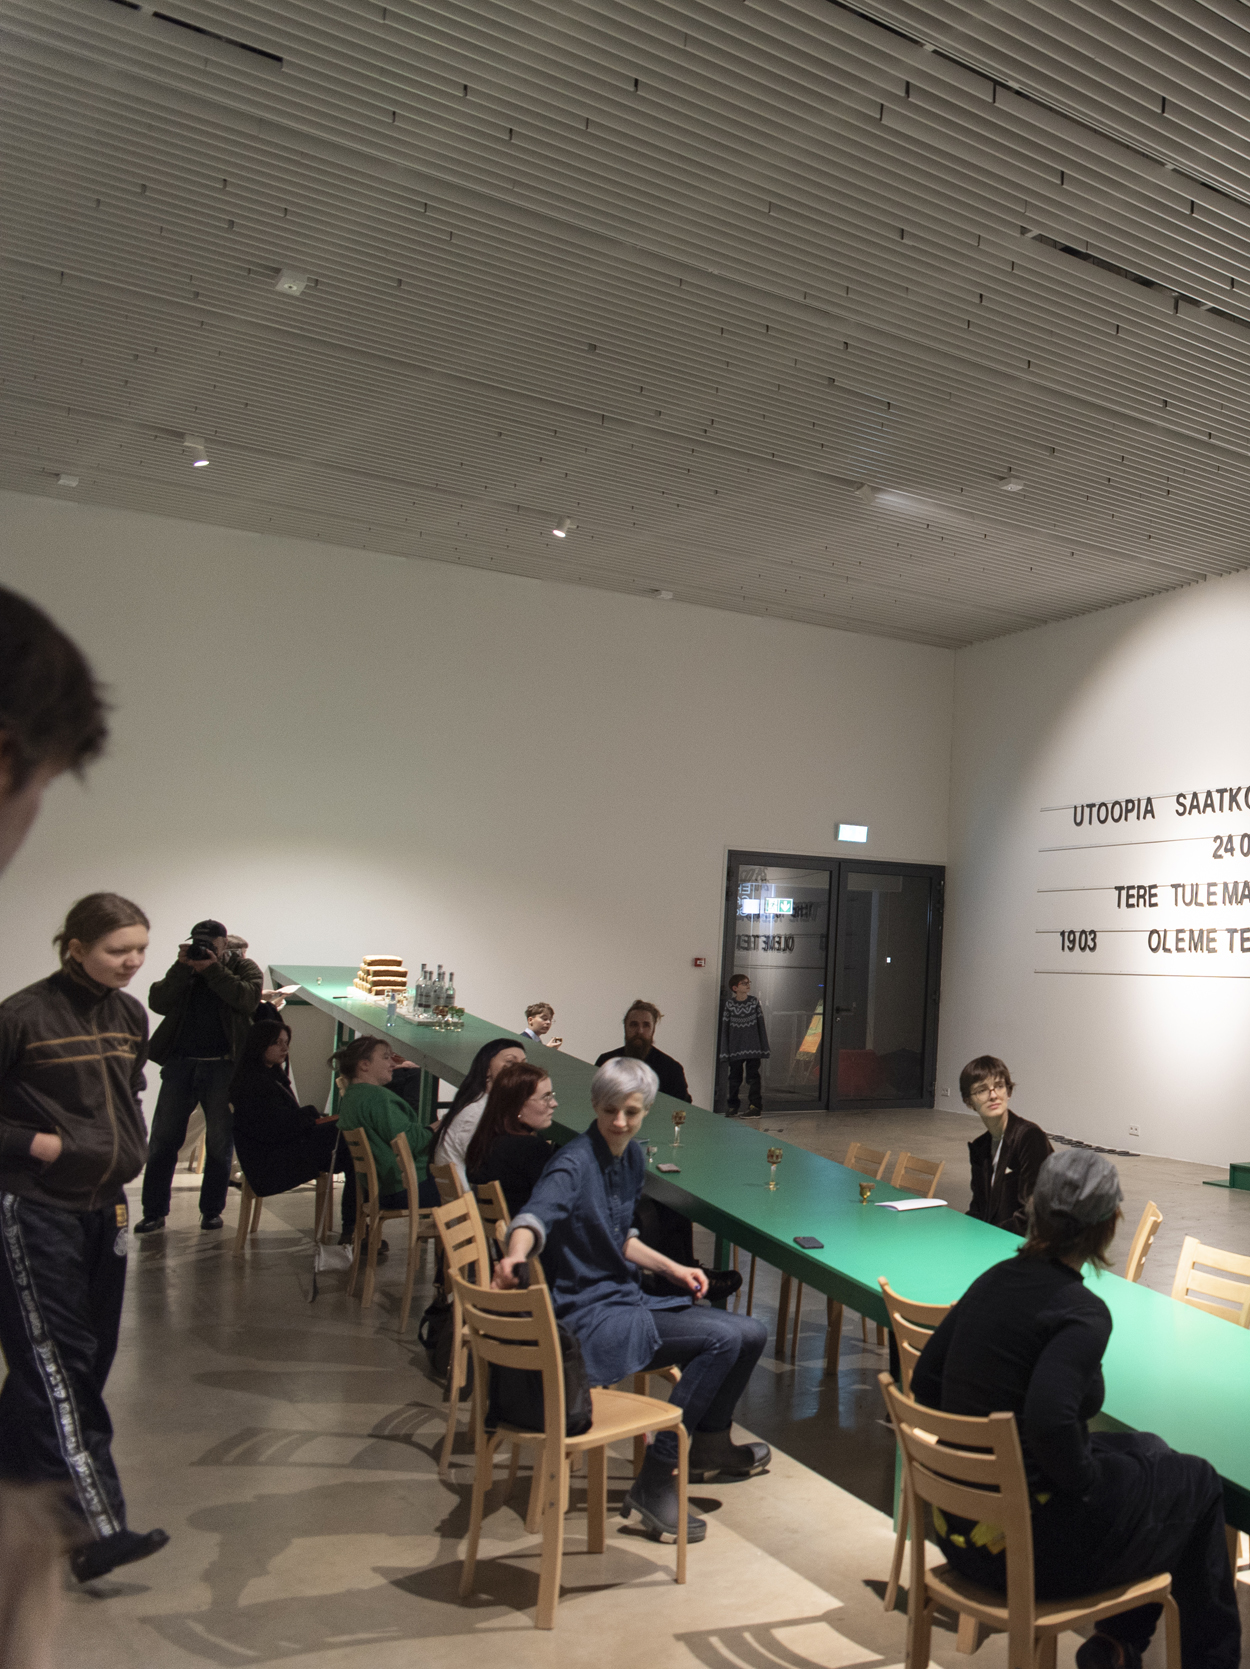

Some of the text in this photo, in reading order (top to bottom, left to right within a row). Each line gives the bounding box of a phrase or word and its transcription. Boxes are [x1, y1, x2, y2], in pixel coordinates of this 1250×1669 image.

[1073, 796, 1156, 827] UTOOPIA
[1114, 884, 1158, 909] TERE
[1060, 929, 1098, 953] 1903
[1148, 928, 1218, 954] OLEME
